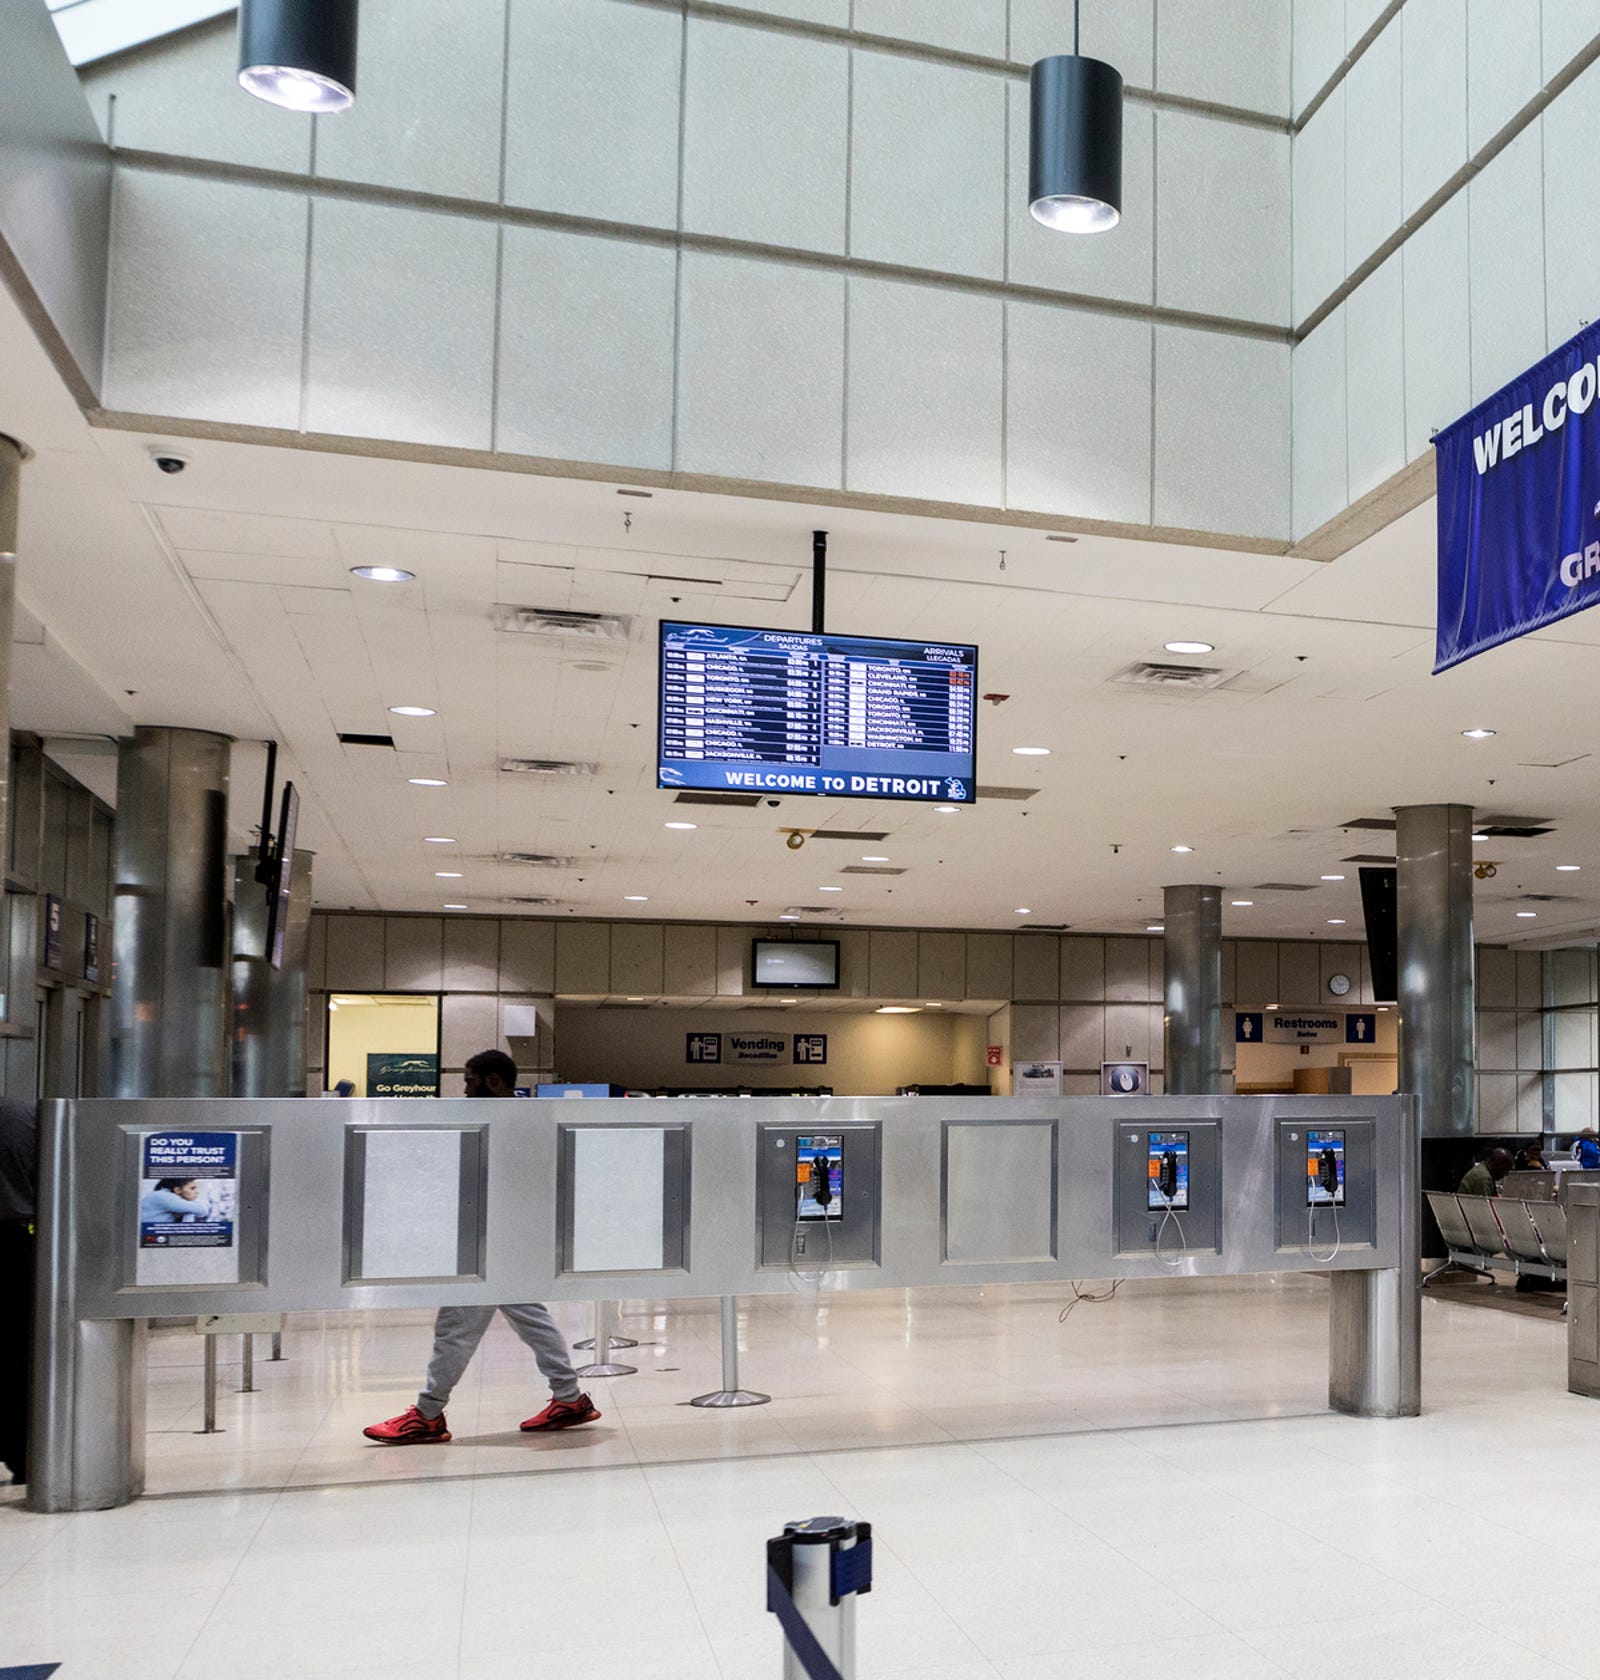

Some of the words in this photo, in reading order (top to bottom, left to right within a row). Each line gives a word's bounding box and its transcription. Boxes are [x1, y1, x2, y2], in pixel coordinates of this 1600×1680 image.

[764, 634, 823, 646] DEPARTURES
[778, 643, 809, 651] SALIDAS
[923, 647, 964, 658] ARRIVALS
[926, 655, 962, 664] LLEGADAS
[725, 771, 816, 789] WELCOME
[821, 776, 845, 790] TO
[851, 775, 941, 795] DETROIT
[1274, 1018, 1338, 1029] Restrooms
[731, 1038, 784, 1052] Vending
[376, 1084, 391, 1092] Go
[150, 1138, 168, 1146] DO
[169, 1138, 194, 1146] YOU
[150, 1146, 189, 1155] REALLY
[190, 1147, 226, 1155] TRUST
[176, 1156, 225, 1164] PERSON?
